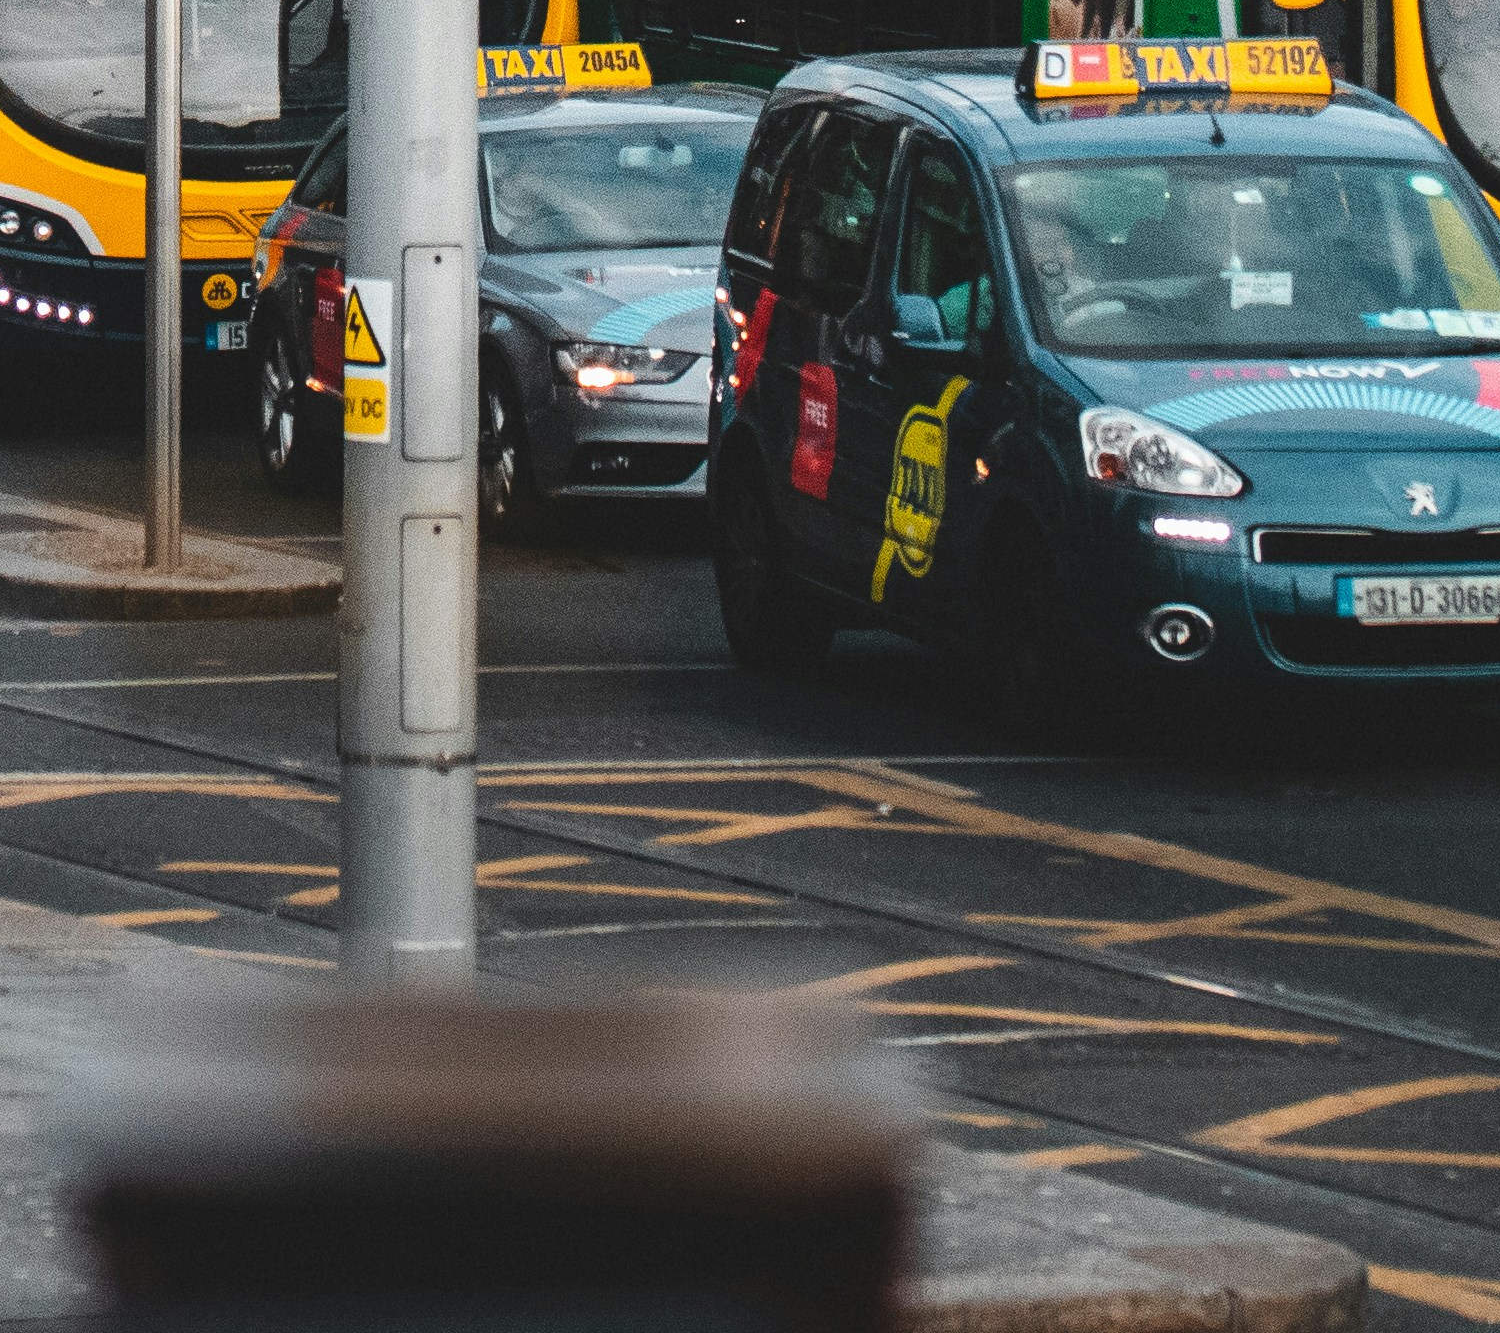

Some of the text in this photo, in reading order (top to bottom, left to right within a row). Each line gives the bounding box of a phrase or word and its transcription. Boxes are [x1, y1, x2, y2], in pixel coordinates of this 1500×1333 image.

[487, 49, 640, 78] TAXI 20454
[1045, 52, 1065, 79] D
[1138, 46, 1228, 83] TAXI
[1249, 45, 1321, 76] 52192
[361, 398, 382, 419] DC
